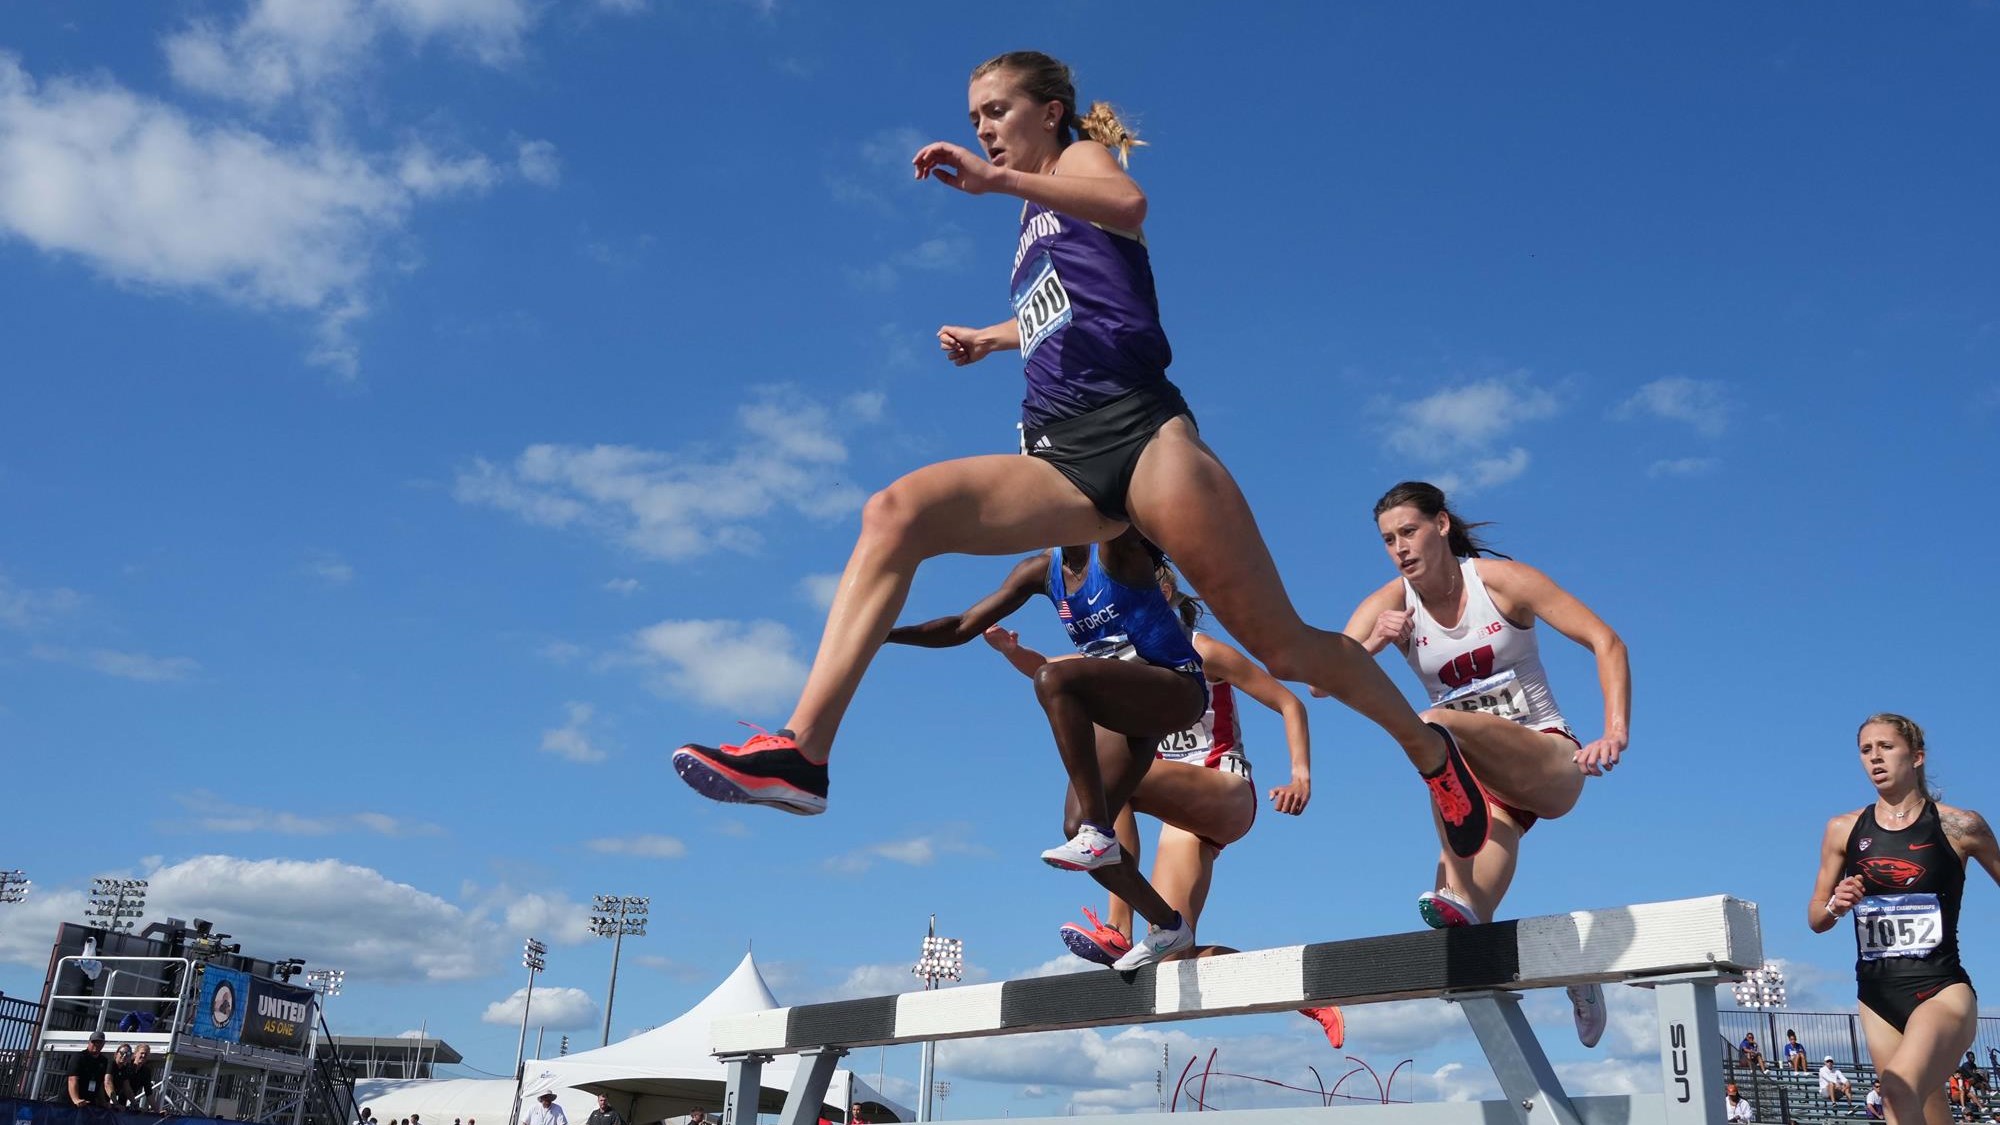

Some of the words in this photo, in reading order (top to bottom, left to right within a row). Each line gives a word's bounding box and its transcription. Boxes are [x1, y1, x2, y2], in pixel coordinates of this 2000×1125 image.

[1076, 603, 1120, 632] FORCE
[1865, 917, 1937, 948] 1052
[257, 995, 306, 1023] UNITED
[263, 1020, 276, 1033] AS
[276, 1022, 294, 1037] ONE
[1670, 1023, 1690, 1103] UCS
